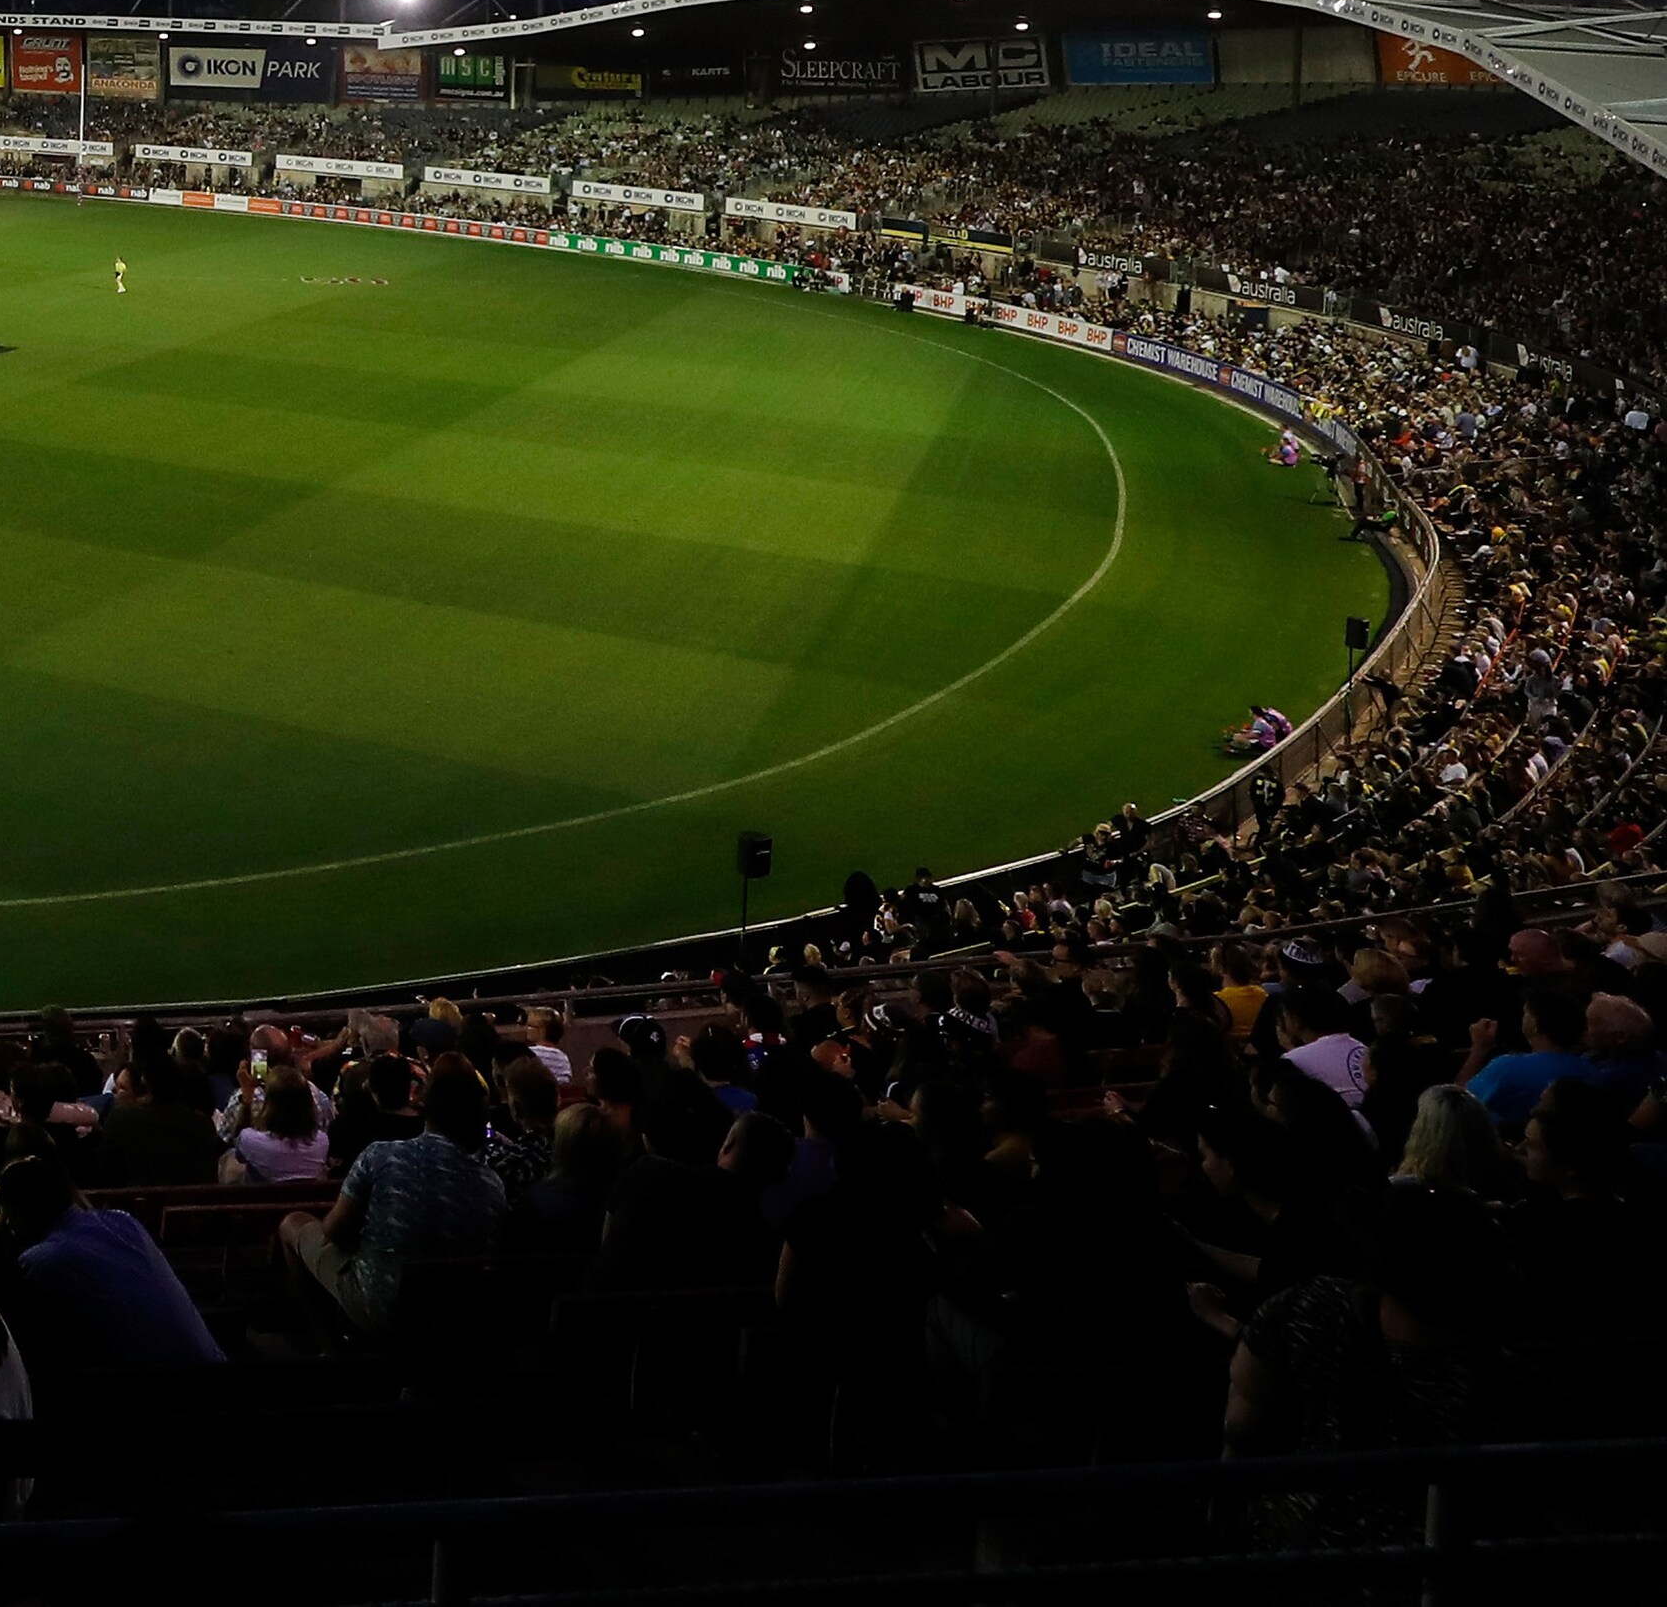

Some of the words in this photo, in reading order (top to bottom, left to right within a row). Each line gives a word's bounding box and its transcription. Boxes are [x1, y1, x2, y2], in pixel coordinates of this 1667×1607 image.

[32, 17, 86, 25] STAND
[1102, 42, 1203, 57] IDEAL
[207, 60, 256, 76] IKON
[267, 62, 321, 78] PARK
[692, 67, 730, 76] KARTS
[94, 79, 156, 89] ANACONDA
[923, 72, 1046, 89] LABOUR
[1397, 71, 1446, 83] EPICURE
[2, 179, 18, 187] nab
[33, 181, 50, 190] nab
[98, 186, 114, 195] nab
[131, 190, 147, 198] nab
[550, 234, 569, 248] nib
[578, 238, 597, 252] nib
[605, 242, 625, 256] nib
[633, 246, 652, 259] nib
[660, 247, 680, 263] nib
[684, 250, 704, 267] nib
[712, 254, 732, 271] nib
[1087, 251, 1142, 275] australia
[739, 260, 759, 276] nib
[767, 264, 786, 280] nib
[1241, 280, 1296, 305] australia
[934, 296, 954, 309] BHP
[997, 307, 1017, 320] BHP
[1028, 314, 1048, 329] BHP
[1059, 321, 1078, 336] BHP
[1393, 313, 1443, 341] australia
[1087, 328, 1107, 343] BHP
[1127, 337, 1165, 364] CHEMIST
[1167, 348, 1218, 381] WAREHOUSE
